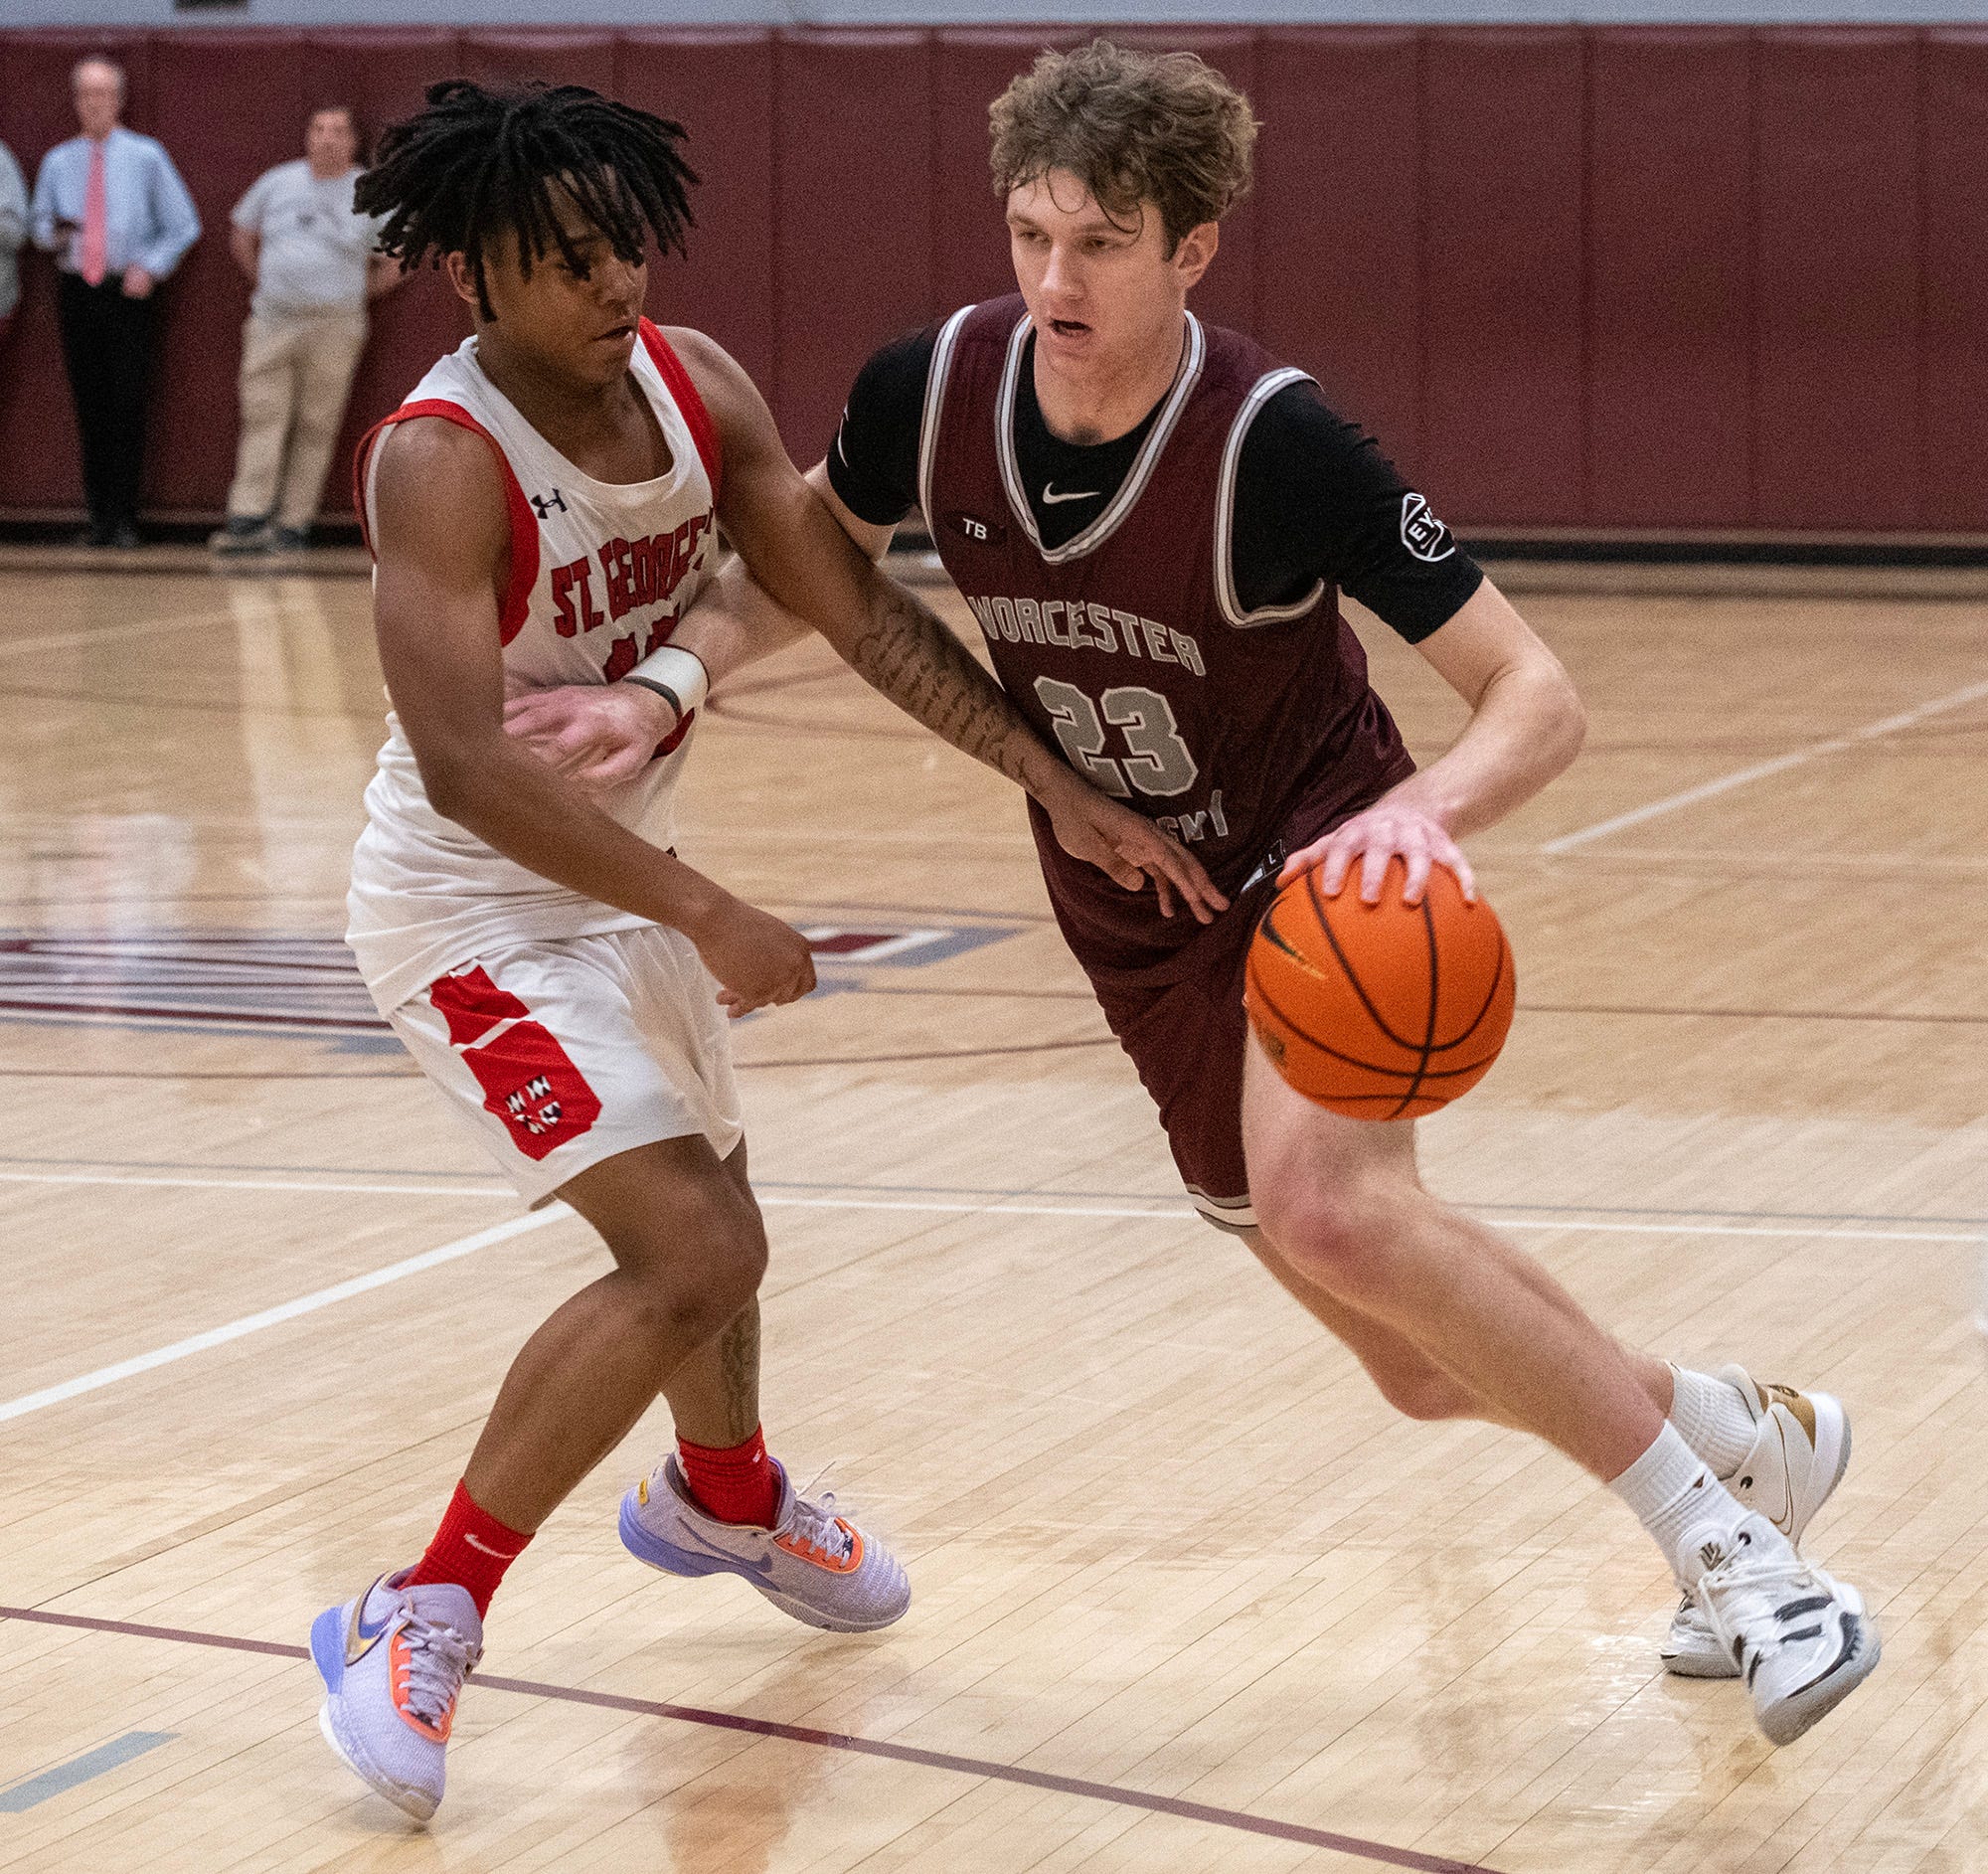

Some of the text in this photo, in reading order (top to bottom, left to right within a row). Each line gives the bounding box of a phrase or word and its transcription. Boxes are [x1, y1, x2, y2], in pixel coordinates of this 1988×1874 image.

[962, 517, 987, 541] TB
[968, 596, 1207, 677] WORCESTER
[1033, 675, 1199, 798] 23
